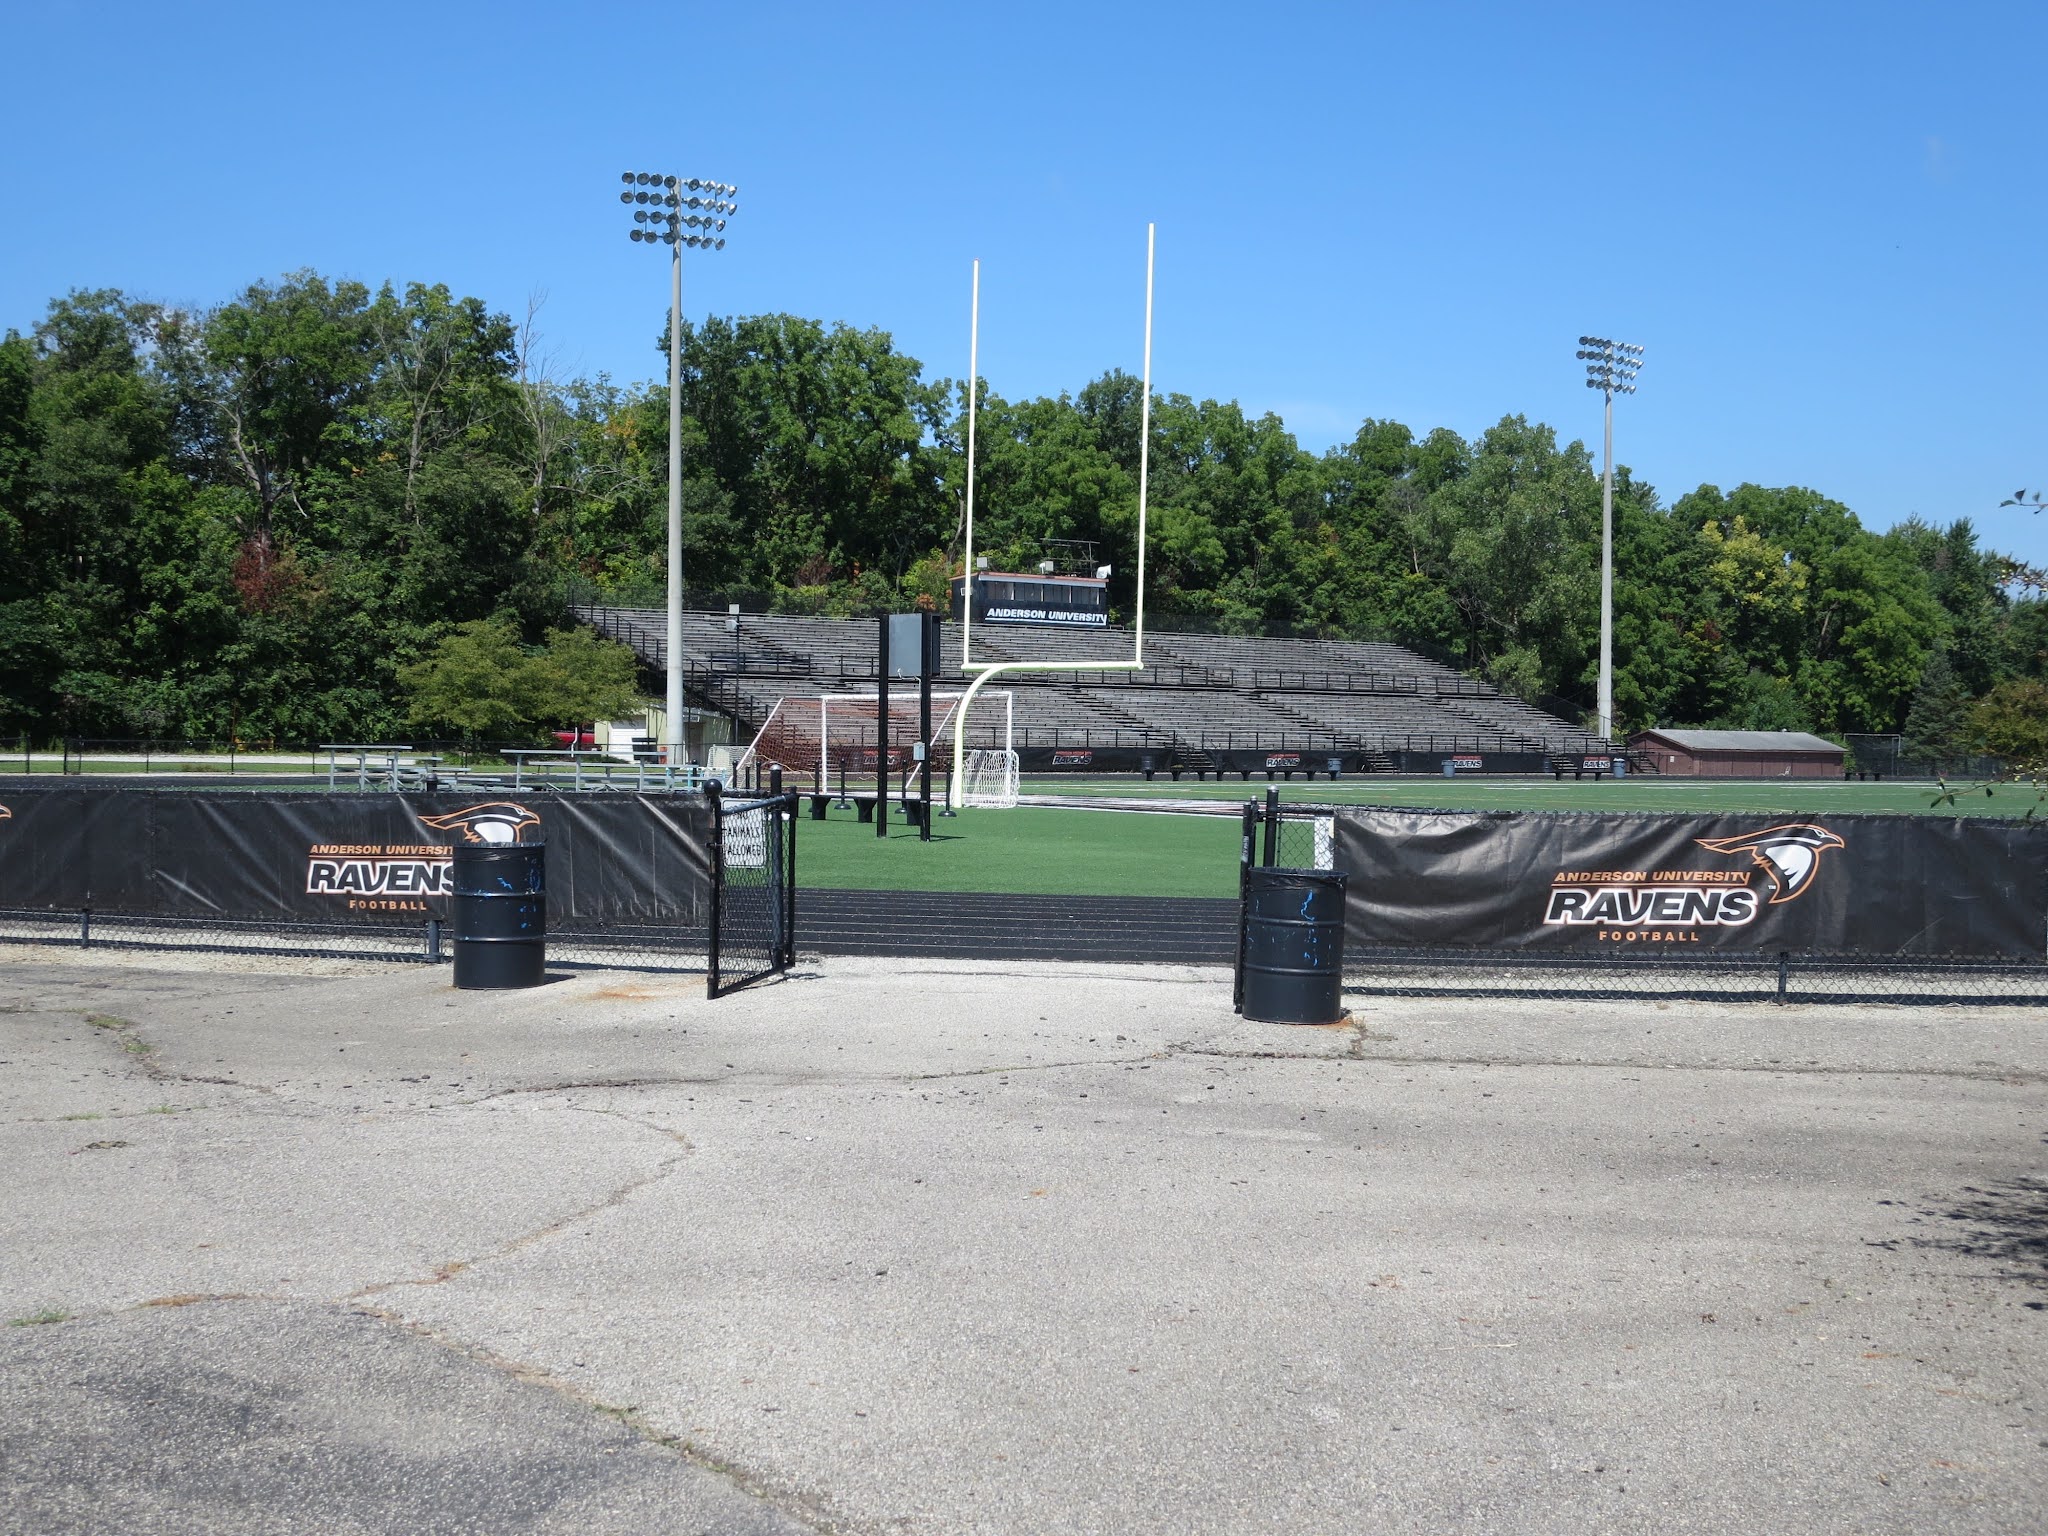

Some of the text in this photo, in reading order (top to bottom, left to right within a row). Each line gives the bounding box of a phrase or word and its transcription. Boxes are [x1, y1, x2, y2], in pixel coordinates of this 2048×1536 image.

[987, 608, 1108, 625] ANDERSON UNIVERSITY
[1052, 755, 1092, 765] RAVENS
[310, 844, 453, 855] ANDERSON UNIVERSIT
[1554, 871, 1750, 885] ANDERSON UNIVERSITY
[350, 900, 427, 911] FOOTBALL
[1543, 887, 1758, 925] RAVENS
[1599, 931, 1699, 941] FOOTBALL
